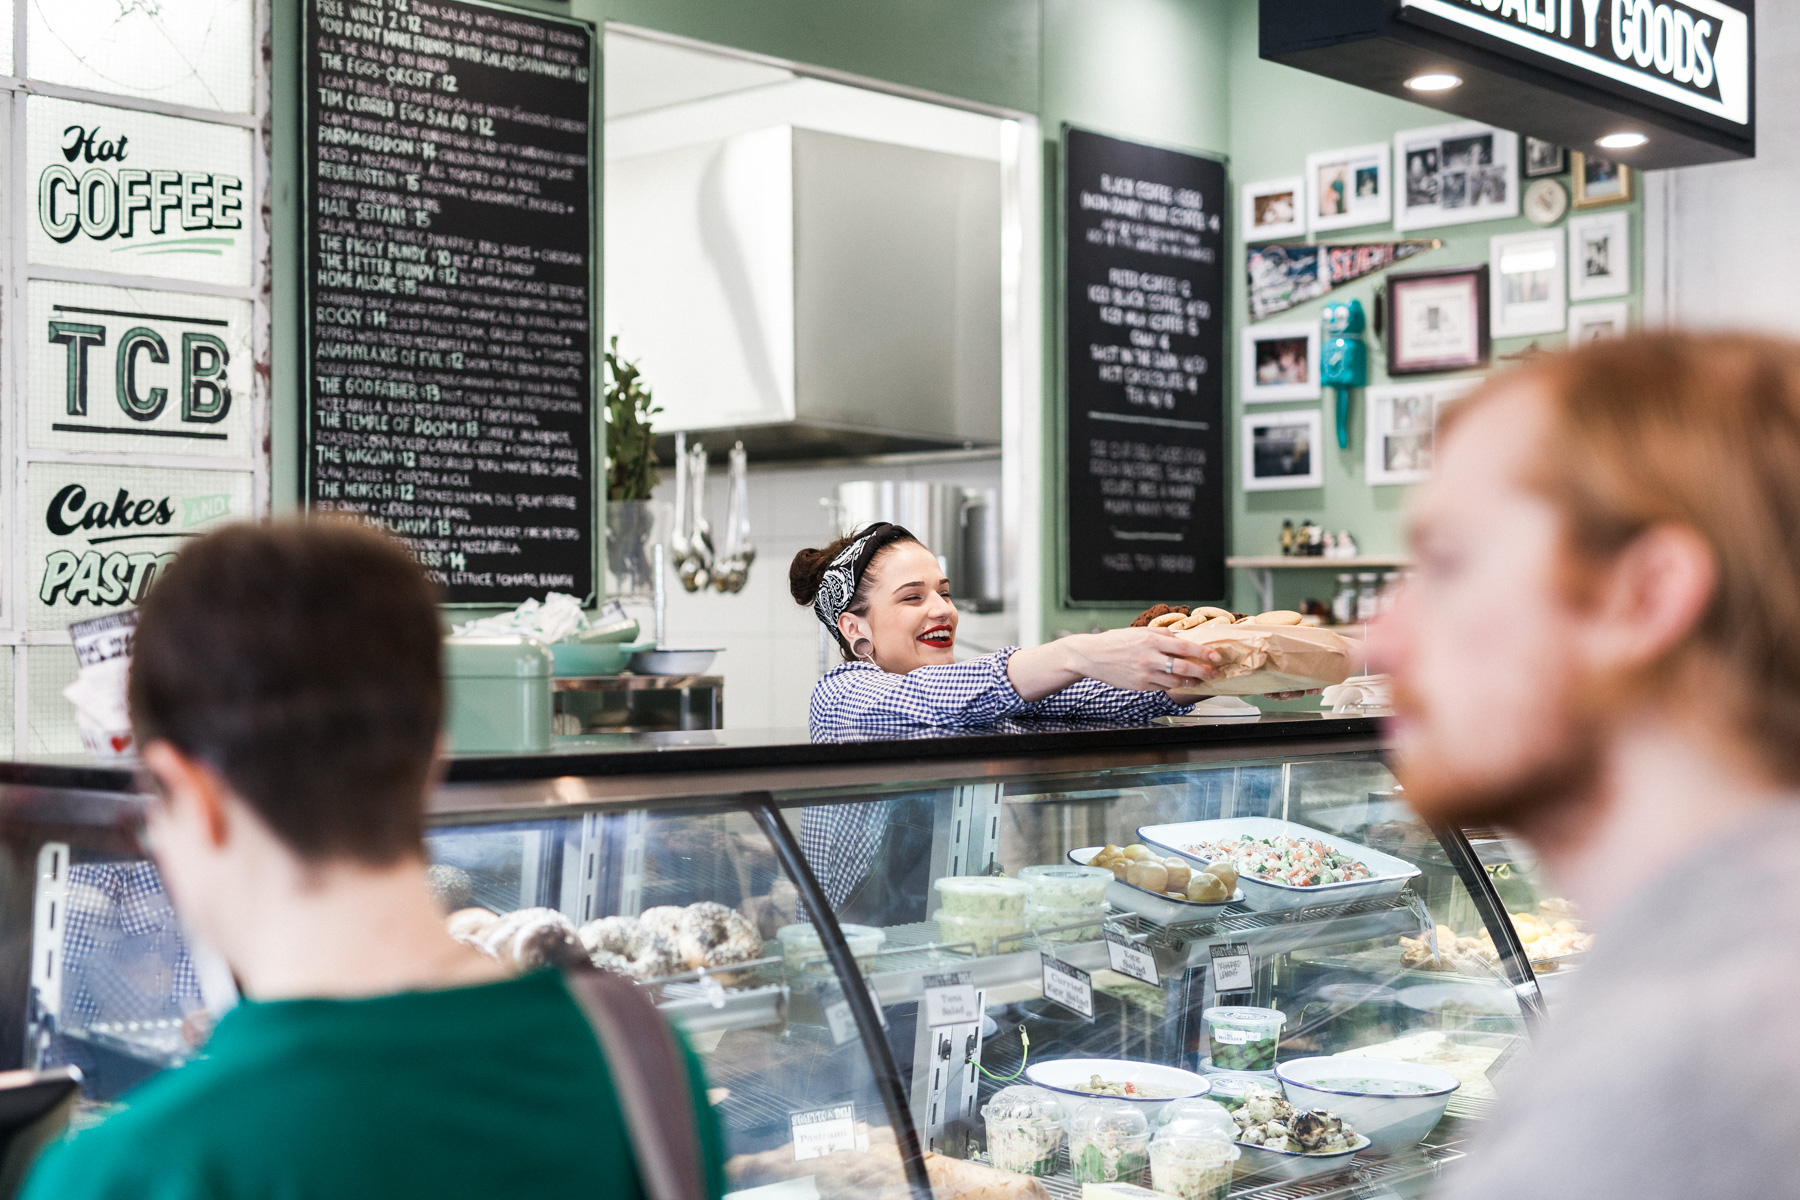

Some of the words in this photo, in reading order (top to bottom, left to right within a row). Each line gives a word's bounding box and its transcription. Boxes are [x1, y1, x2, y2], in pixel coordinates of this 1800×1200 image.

[316, 0, 345, 18] FREE
[317, 16, 342, 36] YOU
[317, 35, 334, 53] ALL
[339, 39, 358, 57] THE
[360, 43, 394, 64] SALAD
[397, 50, 414, 68] ON
[1611, 0, 1713, 89] GOODS
[319, 51, 343, 72] THE
[317, 87, 343, 108] TIM
[399, 102, 424, 124] EGG
[425, 106, 468, 131] SALAD
[61, 125, 128, 163] Hot
[318, 125, 414, 157] PARMAGEDDON
[39, 164, 242, 243] COFFEE
[318, 196, 350, 218] HAIL
[355, 202, 406, 226] SEITAN!
[318, 233, 343, 252] THE
[346, 236, 385, 258] PIGGY
[387, 242, 427, 263] BUNDY
[317, 268, 353, 289] HOME
[355, 273, 397, 294] ALONE
[318, 251, 343, 270] THE
[346, 254, 393, 276] BETTER
[395, 261, 435, 281] BUNDY
[316, 304, 363, 326] ROCKY
[48, 320, 232, 424] TCB
[400, 348, 416, 366] OF
[316, 374, 342, 393] THE
[345, 377, 419, 400] GODFATHER
[315, 409, 341, 429] THE
[344, 412, 389, 432] TEMPLE
[392, 415, 412, 434] OF
[414, 417, 457, 437] DOOM
[315, 445, 341, 464] THE
[344, 447, 394, 466] WIGGUM
[317, 479, 340, 497] THE
[344, 480, 391, 500] MENSCH
[46, 484, 175, 536] Cakes
[189, 498, 226, 522] AND
[39, 549, 179, 606] PAST
